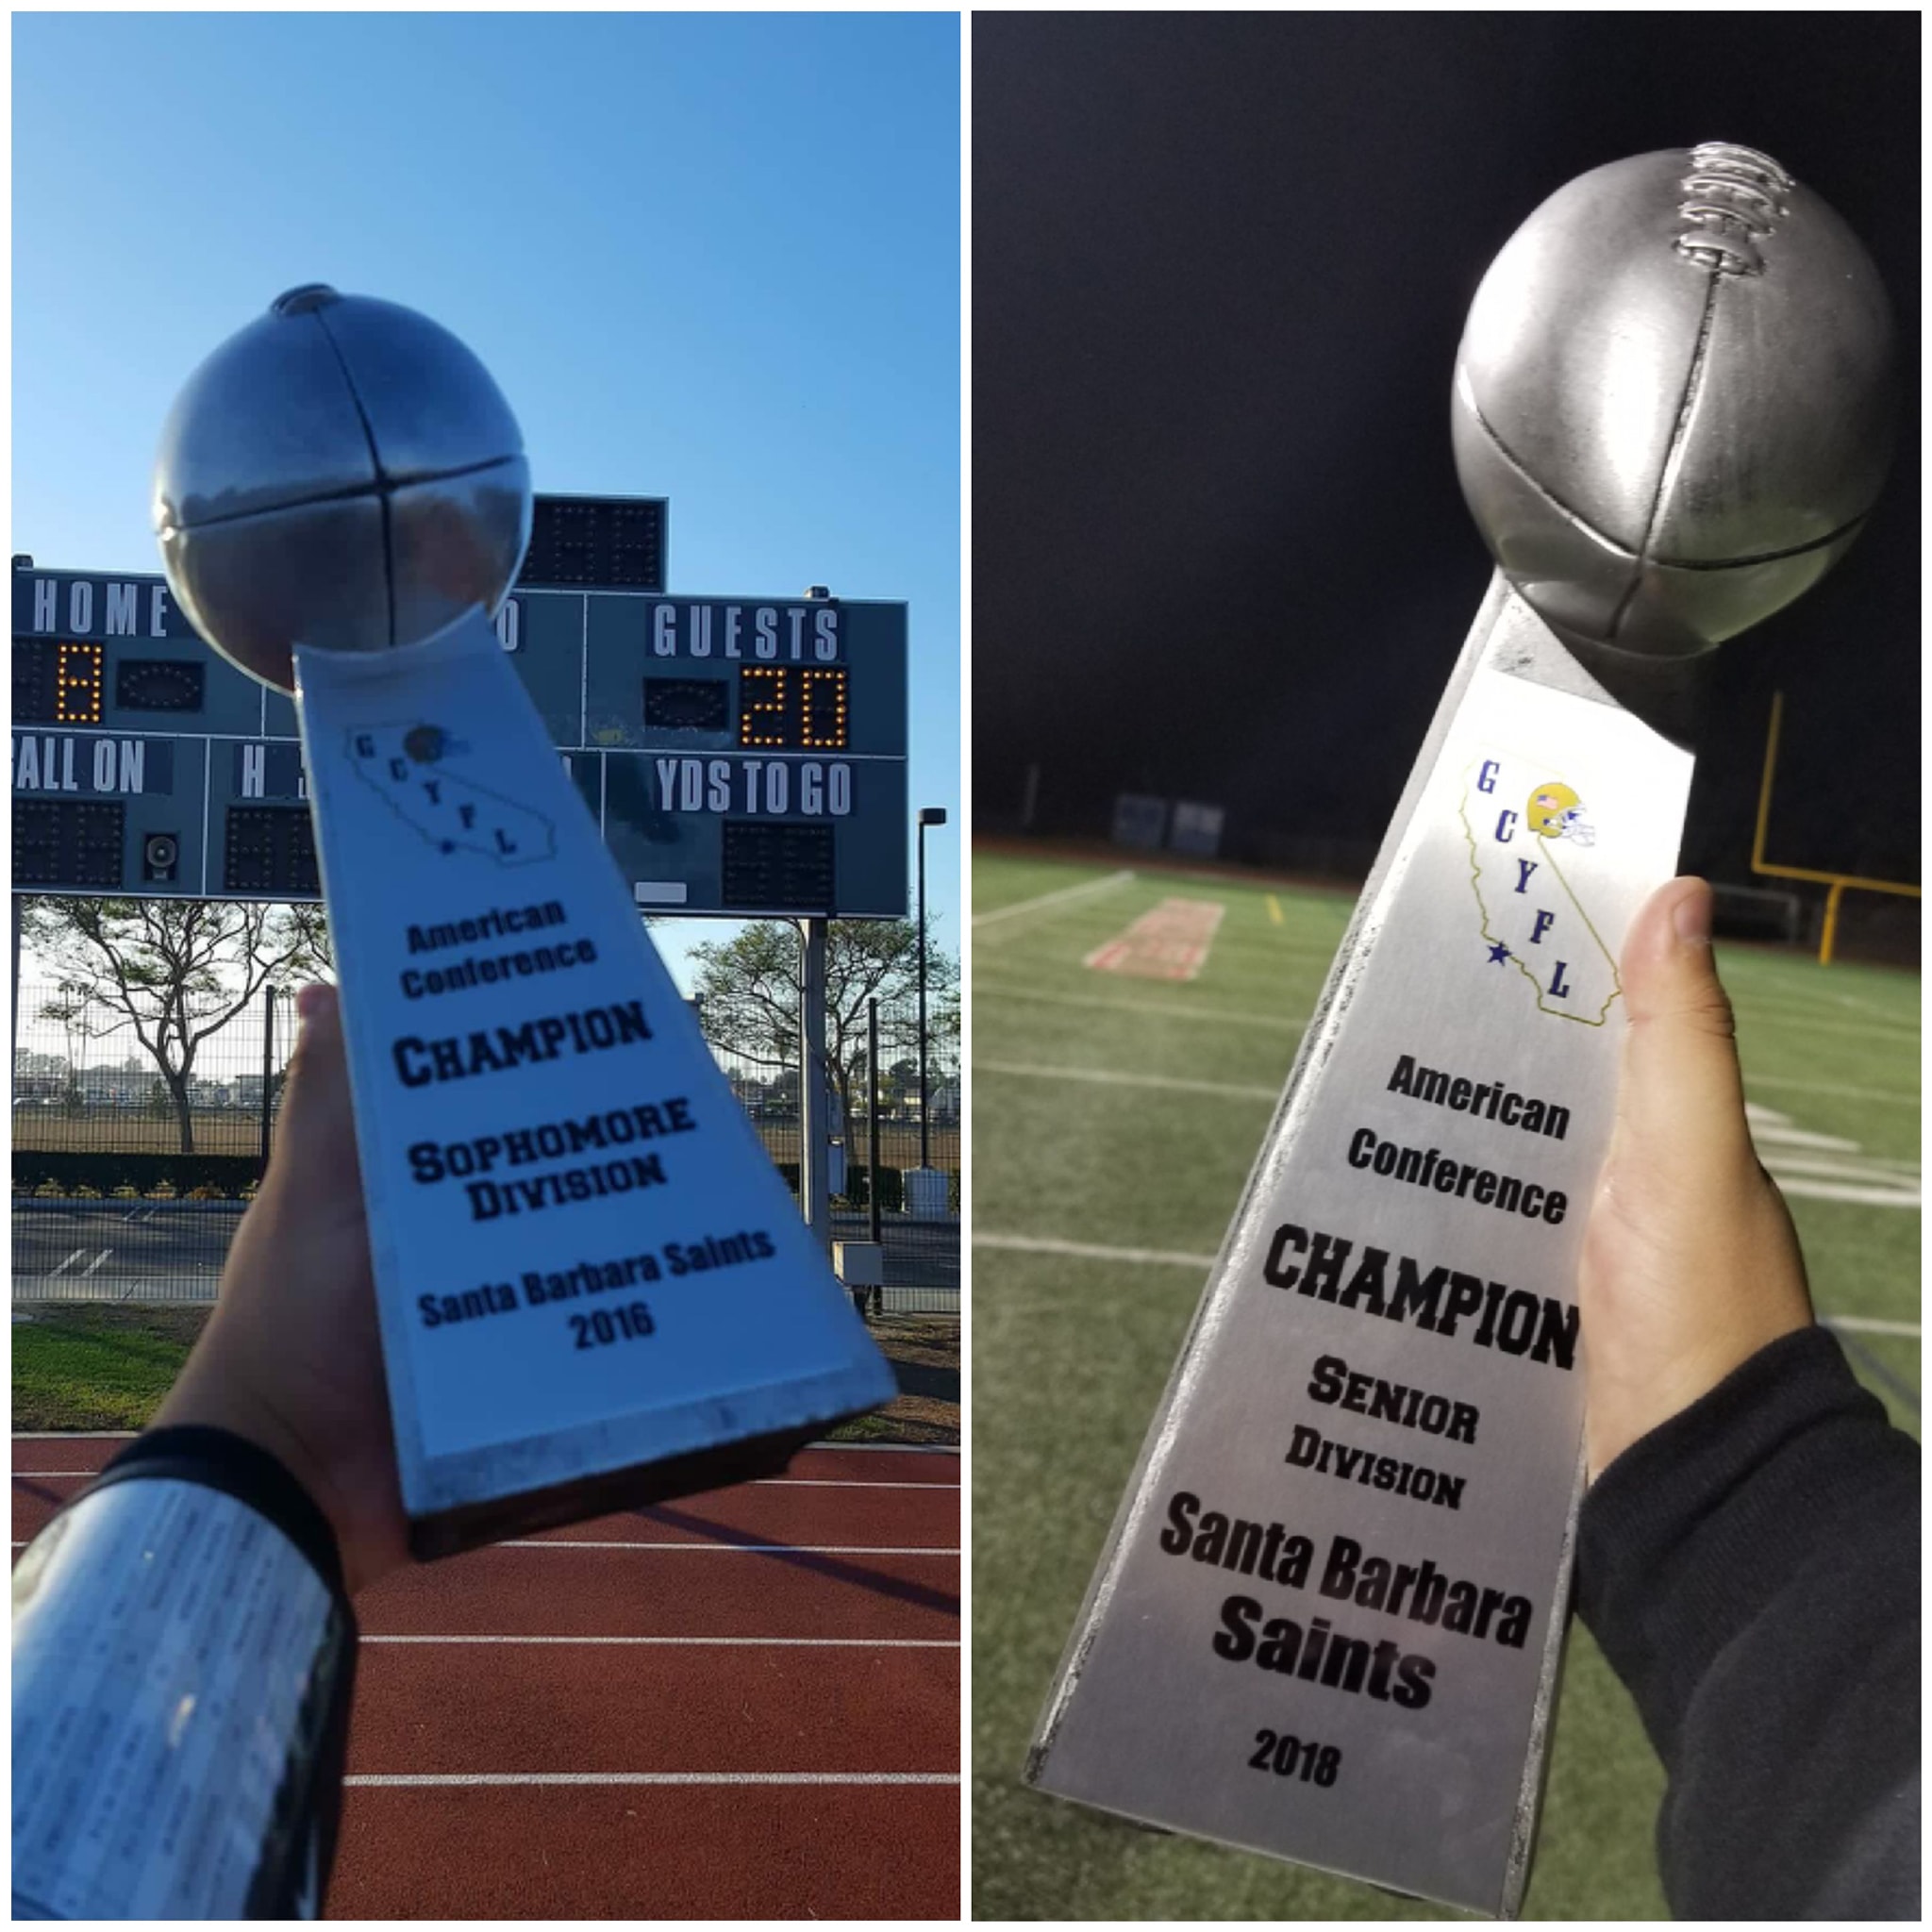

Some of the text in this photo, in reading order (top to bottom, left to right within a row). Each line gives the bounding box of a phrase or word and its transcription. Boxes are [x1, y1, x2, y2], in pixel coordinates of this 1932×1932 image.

[34, 578, 168, 638] HOME
[654, 604, 839, 660] GUESTS
[741, 666, 847, 748] 20
[11, 736, 144, 793] ALL ON
[657, 758, 851, 817] YDS TO GO
[400, 938, 598, 1002] Conference
[406, 900, 568, 956] American
[391, 1001, 655, 1090] CHAMPION
[1387, 1054, 1571, 1141] American
[408, 1097, 697, 1185] SOPHOMORE
[1348, 1127, 1569, 1225] Conference
[465, 1153, 668, 1222] DIVISION
[418, 1230, 777, 1327] Santa Barbara Saints
[1263, 1224, 1581, 1371] CHAMPION
[569, 1301, 657, 1350] 2016
[1307, 1355, 1480, 1444] SENIOR
[1285, 1424, 1467, 1510] DIVISION
[1159, 1491, 1534, 1649] Santa Barbara
[1212, 1594, 1437, 1710] Saints
[1248, 1728, 1342, 1789] 2018
